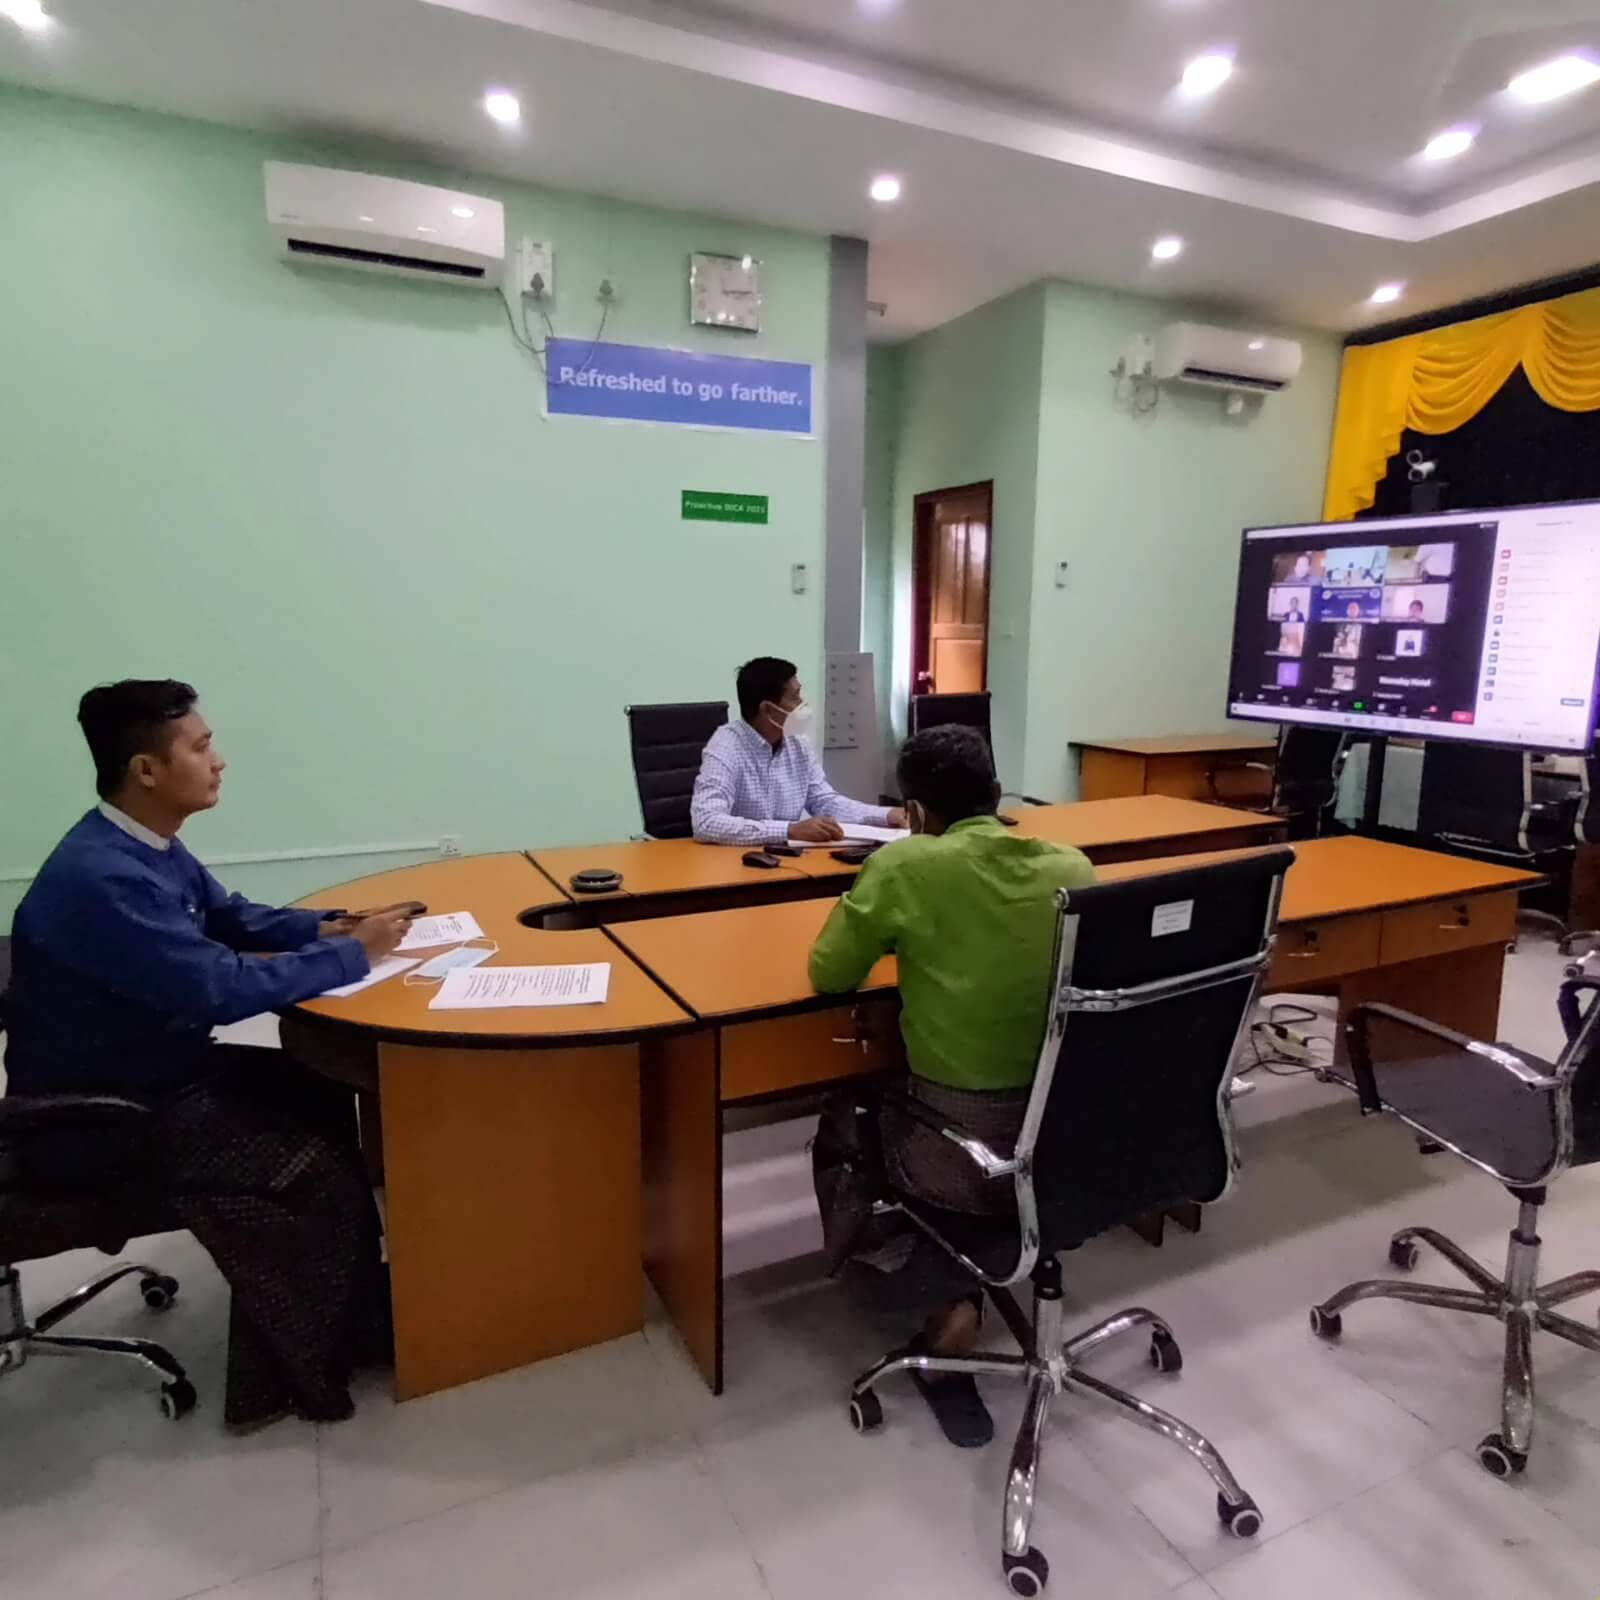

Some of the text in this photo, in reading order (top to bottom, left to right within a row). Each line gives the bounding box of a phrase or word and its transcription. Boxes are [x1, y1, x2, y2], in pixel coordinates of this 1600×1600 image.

[560, 366, 803, 406] Refreshed to go farther.
